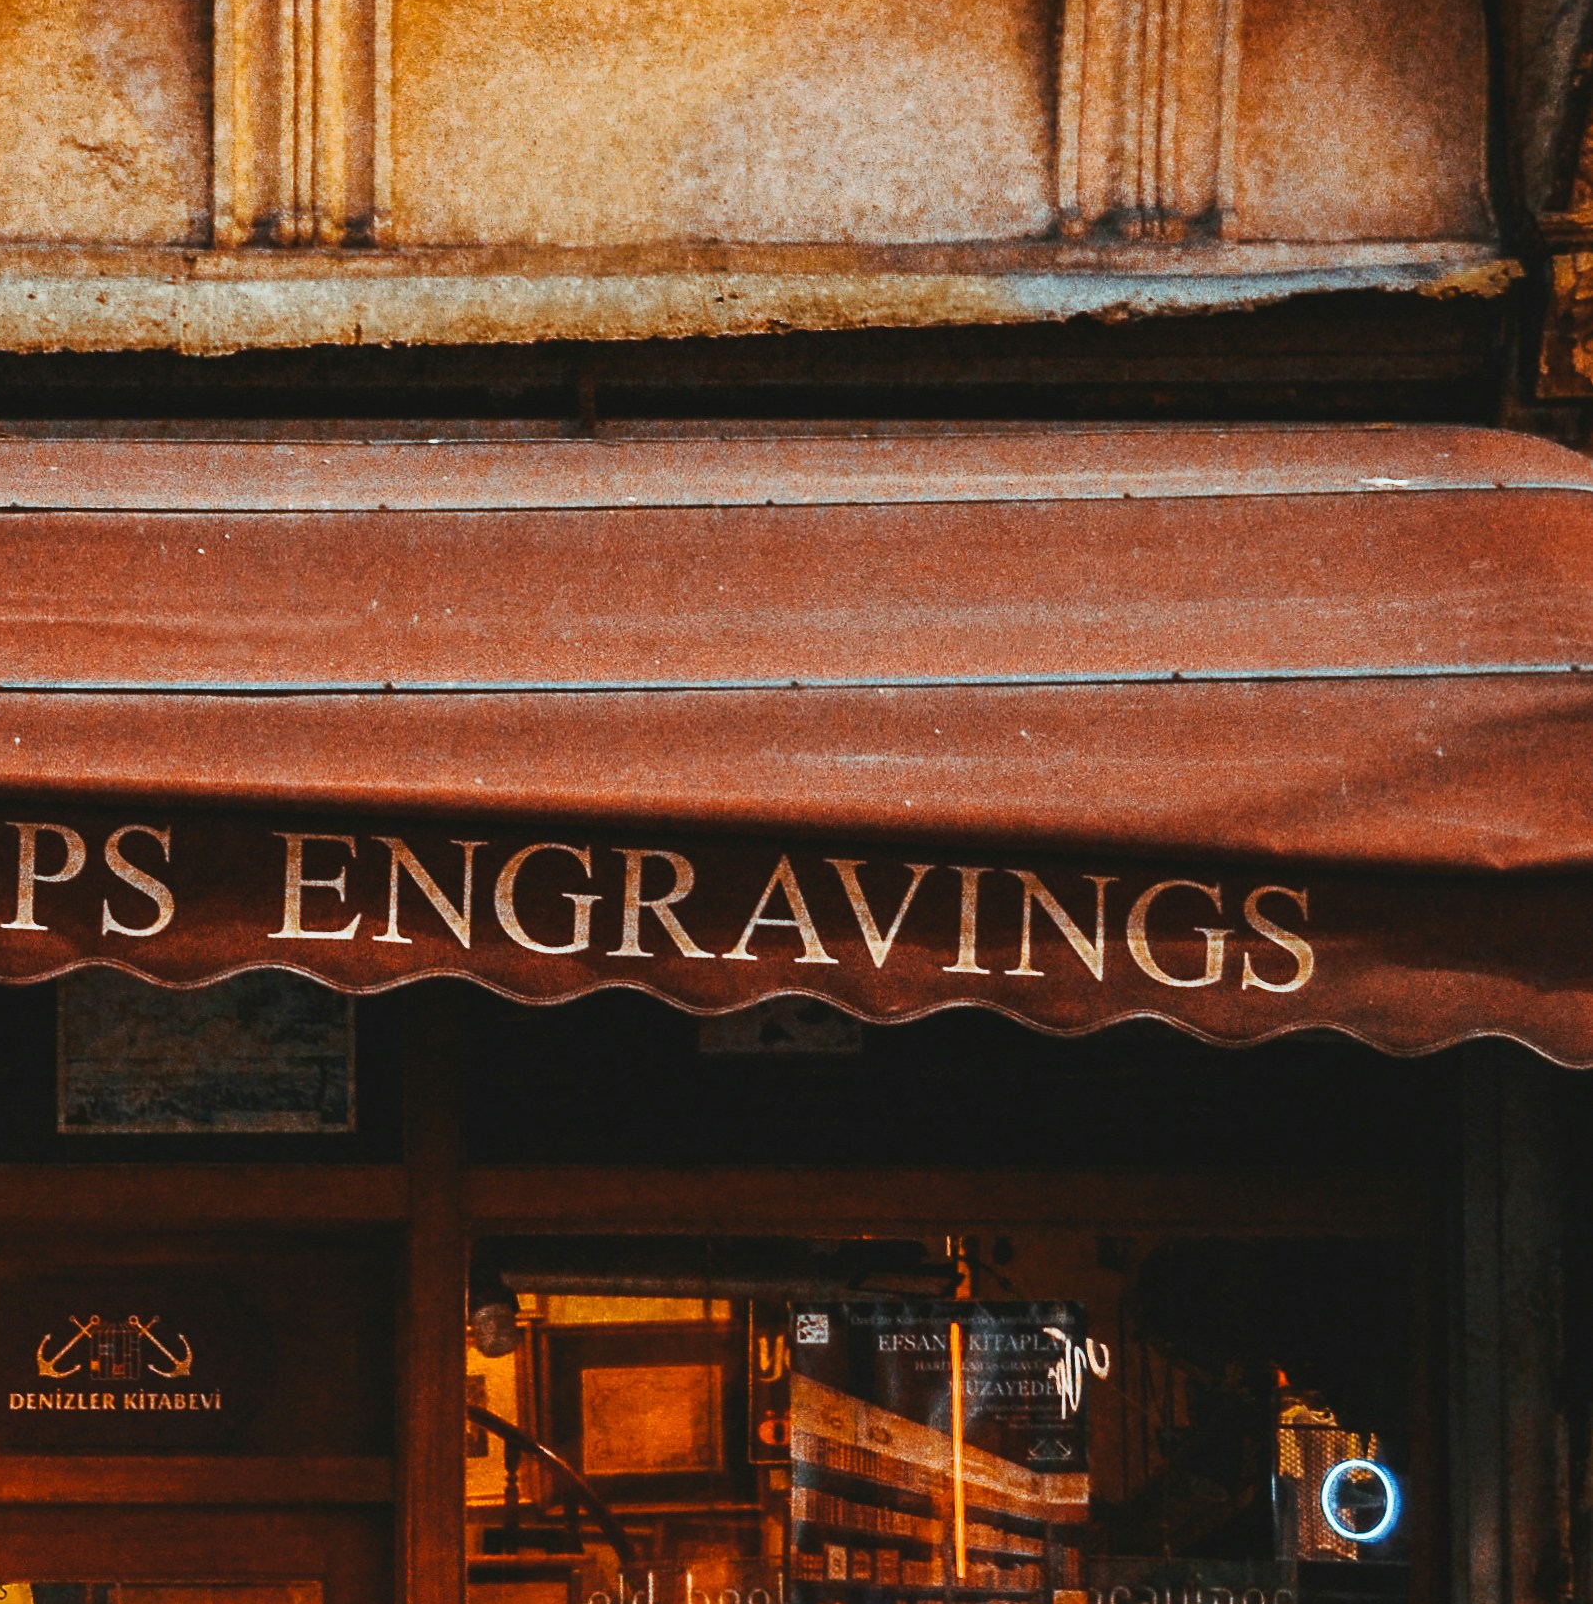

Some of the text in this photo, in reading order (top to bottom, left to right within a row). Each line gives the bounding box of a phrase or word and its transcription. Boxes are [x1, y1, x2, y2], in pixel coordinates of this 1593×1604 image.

[266, 830, 1318, 995] ENGRAVINGS
[878, 1331, 1064, 1352] EFSAN KİTAPLA
[9, 1388, 222, 1410] DENİZLER KİTABEVİ
